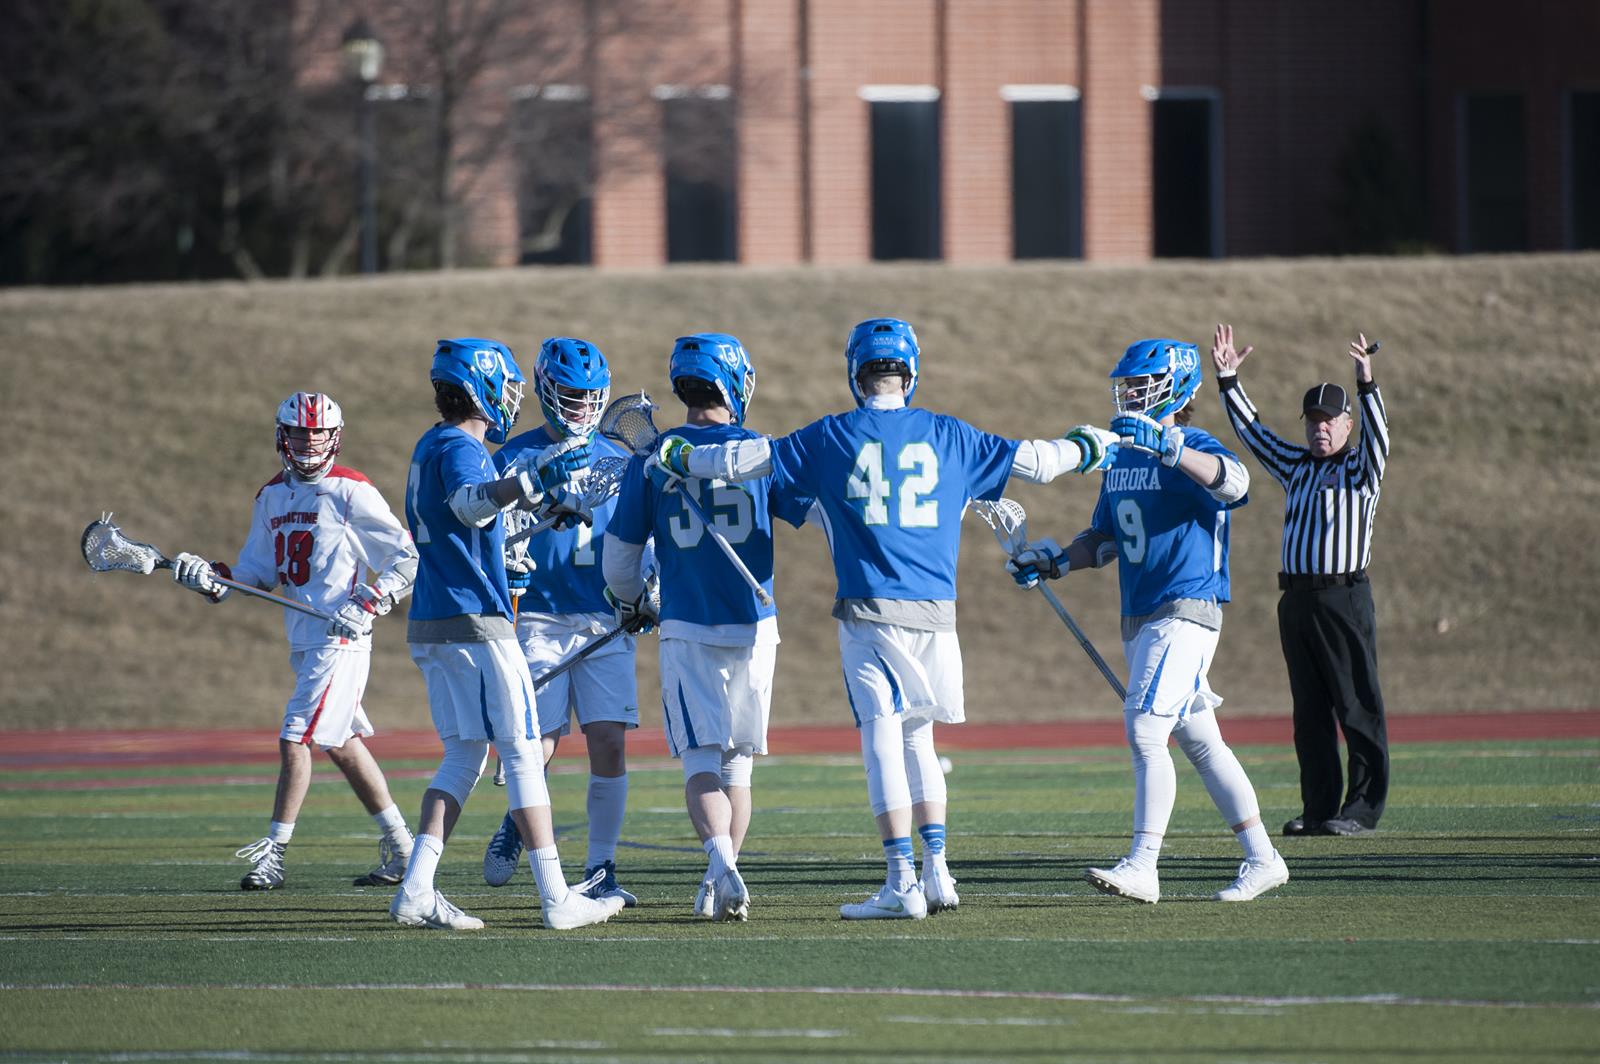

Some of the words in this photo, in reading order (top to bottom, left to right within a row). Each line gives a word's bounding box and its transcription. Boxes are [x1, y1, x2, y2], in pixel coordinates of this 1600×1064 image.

[669, 477, 753, 548] 35
[847, 441, 939, 528] 42
[1116, 499, 1146, 563] 9
